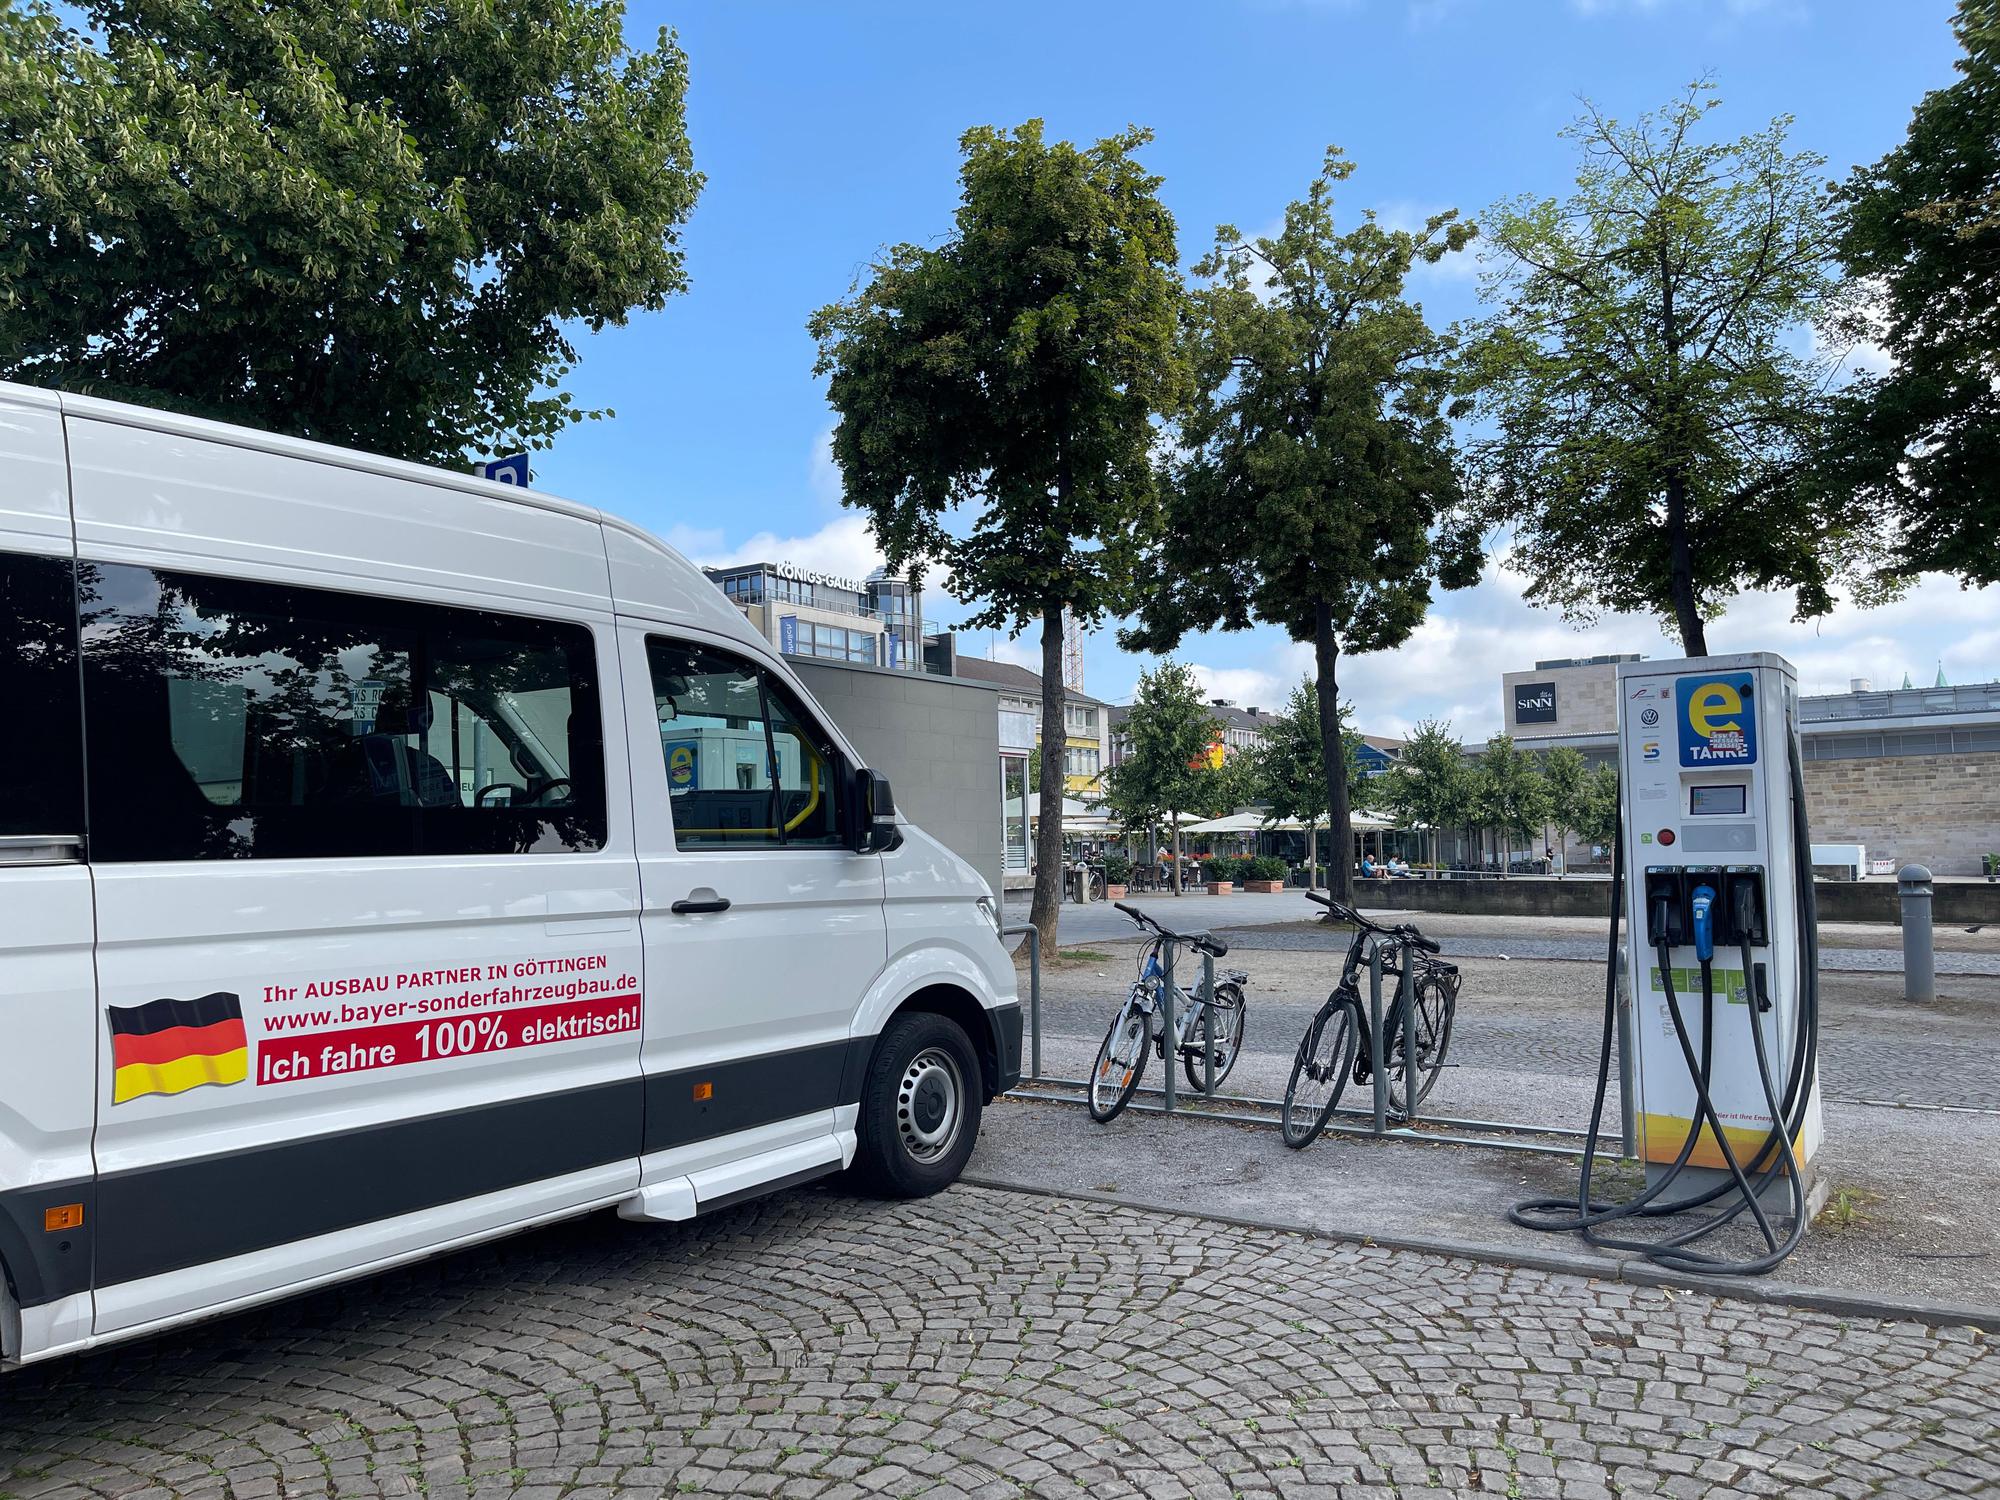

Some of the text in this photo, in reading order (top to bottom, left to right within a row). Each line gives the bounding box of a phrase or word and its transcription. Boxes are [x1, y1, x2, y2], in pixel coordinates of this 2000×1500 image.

[776, 560, 867, 594] KÖNIGS-GALERIE
[1689, 683, 1742, 739] e
[1690, 744, 1748, 760] TANKE
[264, 955, 607, 1003] Ihr AUSBAU PARTNER IN GÖTTINGEN
[264, 974, 637, 1032] www.bayer-sonderfahrzeugbau.de
[263, 1006, 637, 1082] Ich fahre 100% elektrisch!
[1754, 1115, 1774, 1123] Energ
